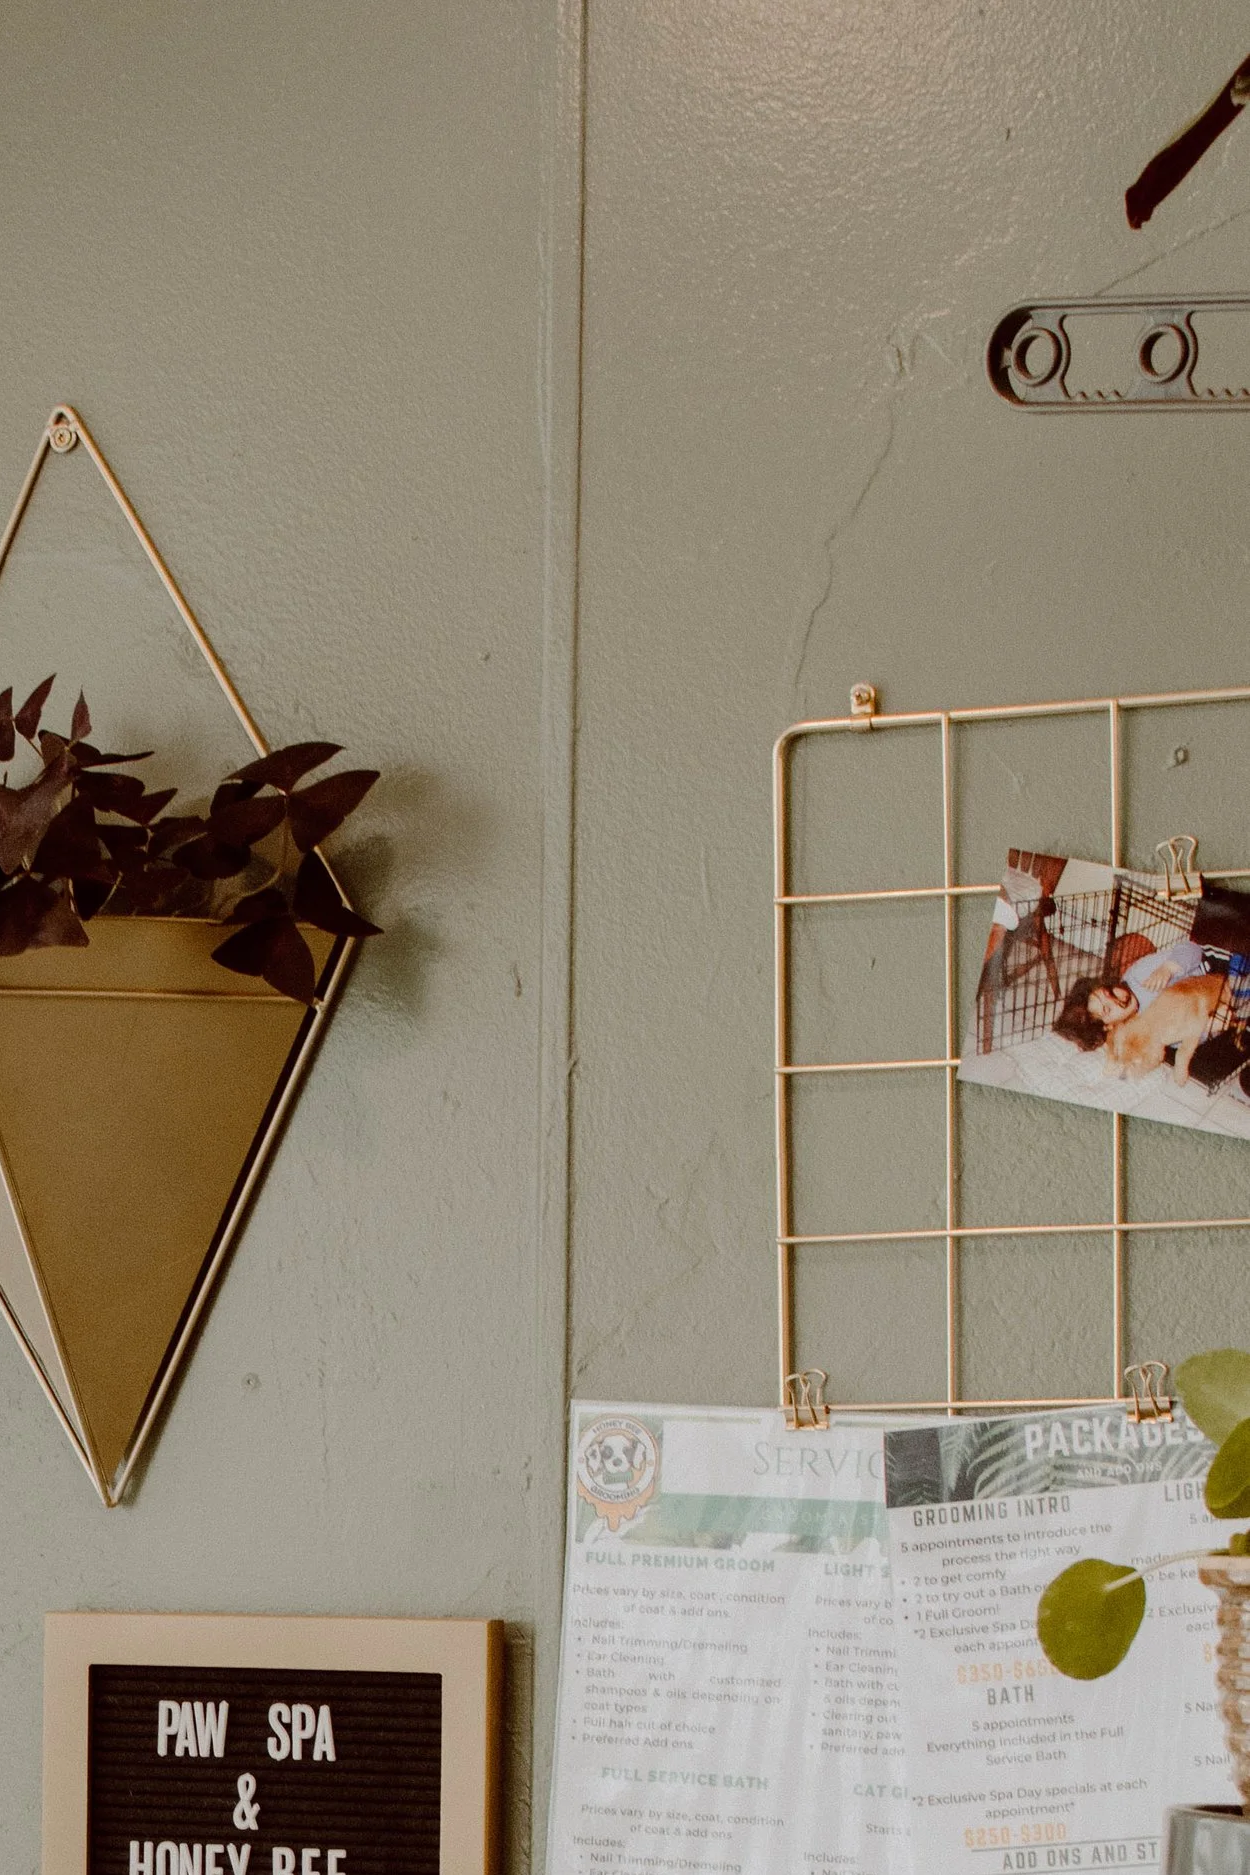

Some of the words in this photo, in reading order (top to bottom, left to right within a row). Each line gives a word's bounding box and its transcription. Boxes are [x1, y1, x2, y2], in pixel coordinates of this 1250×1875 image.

[592, 1421, 624, 1434] HONEY
[913, 1502, 1008, 1527] GROOMING
[1018, 1495, 1072, 1516] INTRO
[901, 1542, 908, 1552] 5
[912, 1533, 1004, 1554] appointments
[1007, 1533, 1020, 1542] to
[1024, 1526, 1086, 1541] introduce
[1090, 1524, 1112, 1535] the
[586, 1551, 626, 1566] FULL
[631, 1554, 708, 1570] PREMIUM
[714, 1557, 775, 1572] GROOM
[942, 1555, 991, 1568] process
[994, 1550, 1016, 1561] the
[1020, 1547, 1051, 1562] right
[1055, 1547, 1081, 1559] way
[824, 1563, 873, 1577] LIGHT
[913, 1575, 920, 1585] 2
[924, 1575, 937, 1584] to
[940, 1572, 962, 1586] get
[965, 1569, 1006, 1584] comfy
[926, 1592, 939, 1602] to
[943, 1589, 960, 1603] try
[963, 1587, 985, 1598] out
[1000, 1582, 1031, 1595] Bath
[926, 1609, 949, 1620] Full
[930, 1624, 989, 1638] Exclusive
[992, 1622, 1016, 1636] Spa
[954, 1642, 985, 1654] each
[987, 1684, 1035, 1706] BATH
[157, 1700, 229, 1757] PAW
[267, 1702, 336, 1761] SPA
[983, 1713, 1075, 1733] appointments
[927, 1737, 996, 1755] Everything
[999, 1732, 1056, 1746] included
[1060, 1731, 1072, 1742] in
[1075, 1729, 1097, 1740] the
[1100, 1727, 1124, 1738] Full
[985, 1752, 1032, 1766] Service
[1036, 1749, 1067, 1761] Bath
[601, 1767, 642, 1782] FULL
[649, 1769, 717, 1787] SERVICE
[723, 1775, 769, 1790] BATH
[233, 1772, 260, 1830] &
[853, 1784, 887, 1798] CAT
[928, 1791, 986, 1805] Exclusive
[990, 1789, 1013, 1803] Spa
[1017, 1787, 1042, 1801] Day
[1045, 1782, 1096, 1799] specials
[1100, 1782, 1112, 1792] at
[1116, 1778, 1148, 1790] each
[1003, 1851, 1038, 1870] ADD
[1047, 1847, 1082, 1867] ONS
[1091, 1844, 1127, 1864] AND
